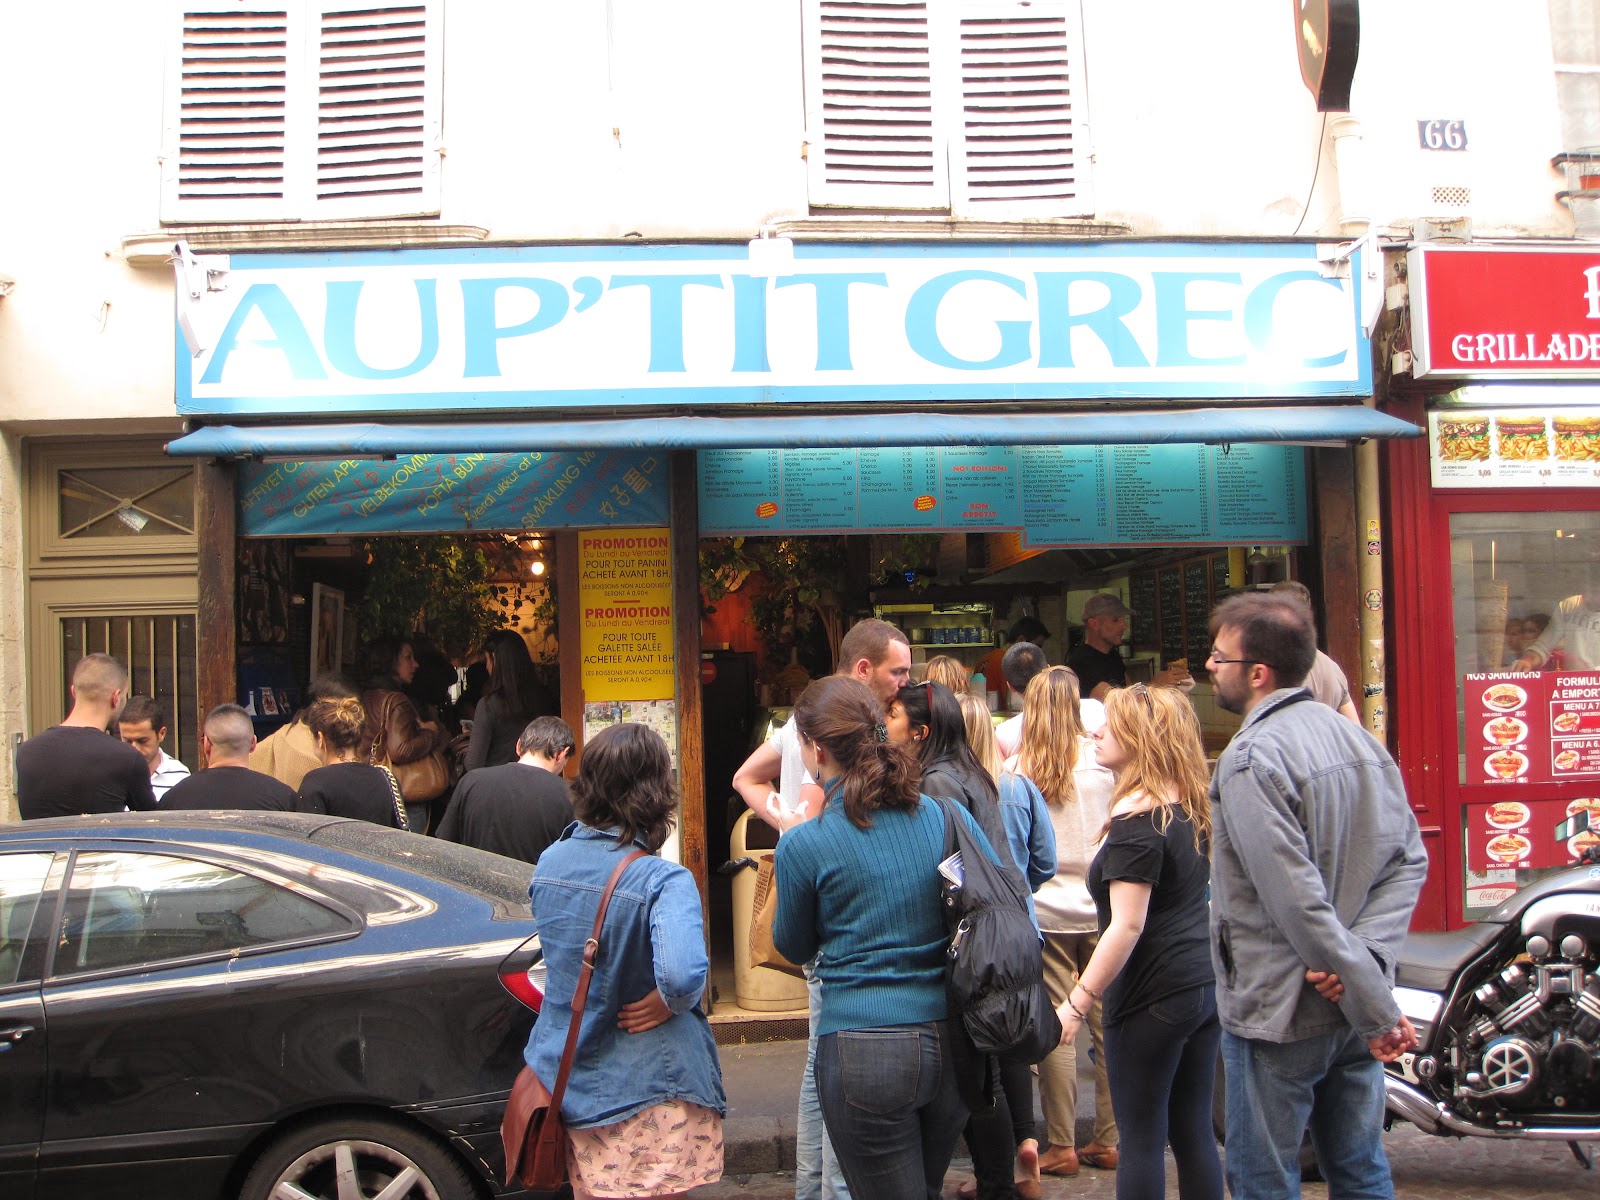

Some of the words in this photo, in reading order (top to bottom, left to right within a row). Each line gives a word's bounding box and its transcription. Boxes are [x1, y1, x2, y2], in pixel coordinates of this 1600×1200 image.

[1424, 121, 1463, 149] 66
[199, 278, 440, 385] AU
[459, 271, 889, 379] P'TIT
[904, 269, 1348, 371] GREC
[293, 477, 335, 518] GUTEN
[583, 537, 668, 550] PROMOTION
[632, 548, 668, 556] Vendredi
[585, 560, 611, 568] POUR
[613, 560, 635, 568] TOUT
[638, 558, 667, 568] PANINI
[619, 570, 648, 578] AVANT
[584, 606, 670, 619] PROMOTION
[602, 633, 628, 642] POUR
[630, 632, 656, 642] TOUTE
[598, 643, 634, 652] GALETTE
[636, 641, 662, 652] SALÉE
[584, 652, 622, 664] ACHETÉE
[625, 654, 654, 664] AVANT
[1552, 690, 1560, 699] A
[1564, 703, 1586, 711] MENU
[1562, 741, 1584, 750] MENU
[1586, 740, 1592, 748] A
